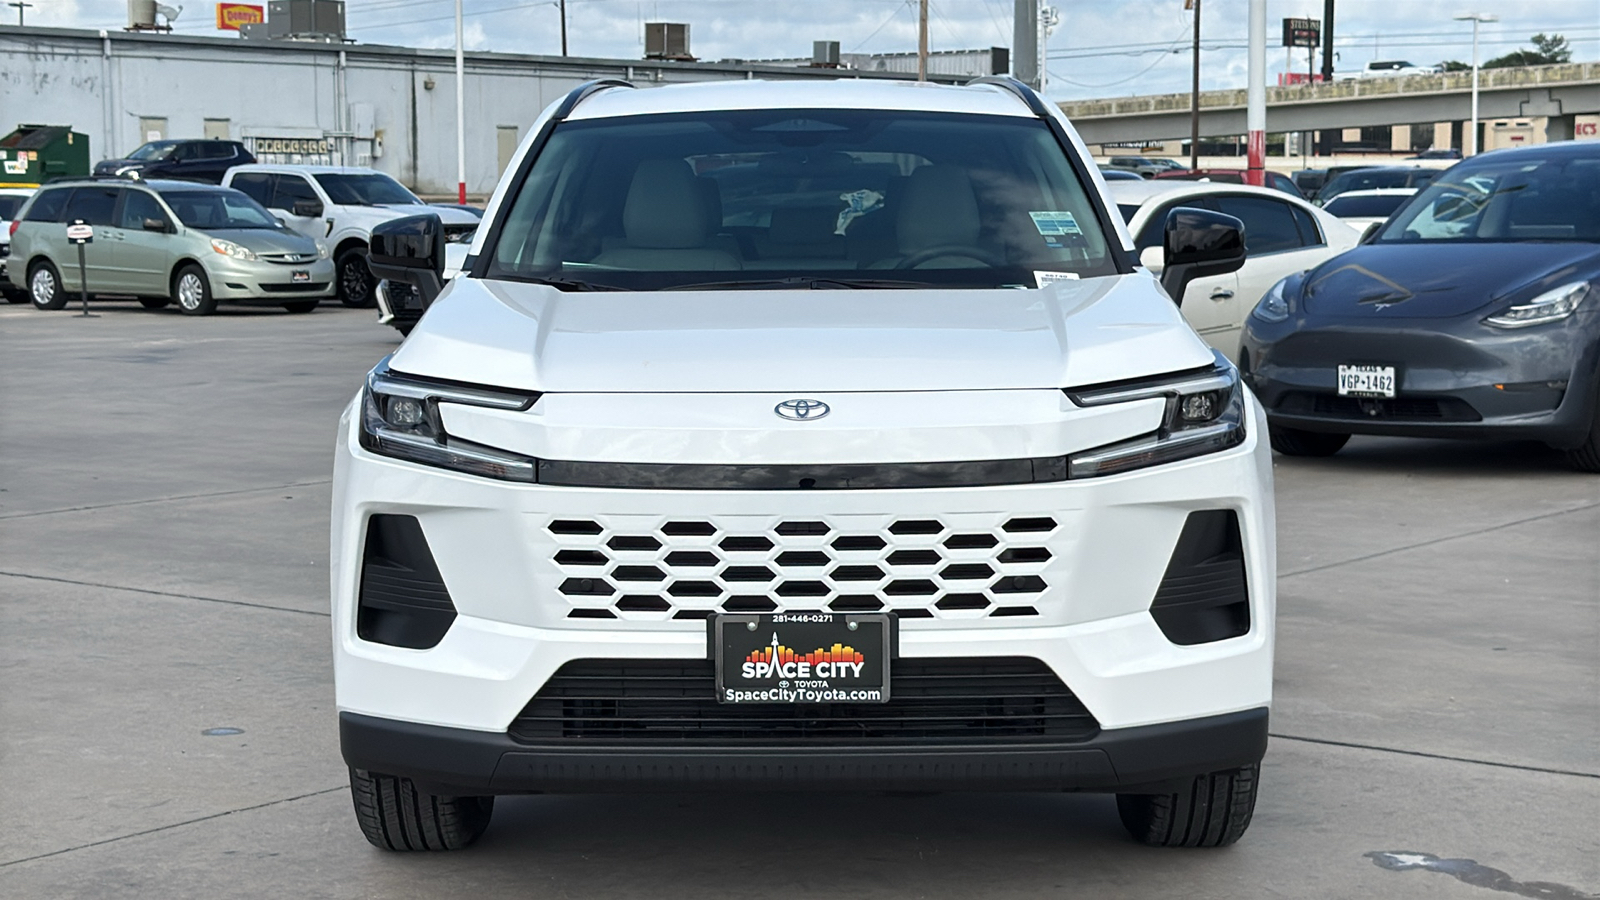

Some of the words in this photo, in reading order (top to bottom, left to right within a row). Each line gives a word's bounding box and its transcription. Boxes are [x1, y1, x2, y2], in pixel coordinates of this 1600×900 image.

[1290, 20, 1320, 31] STETSNS
[772, 614, 833, 623] 281-446-0271
[742, 662, 811, 678] SPACE
[815, 662, 865, 678] CITY
[726, 688, 881, 703] SpaceCityToyota.com
